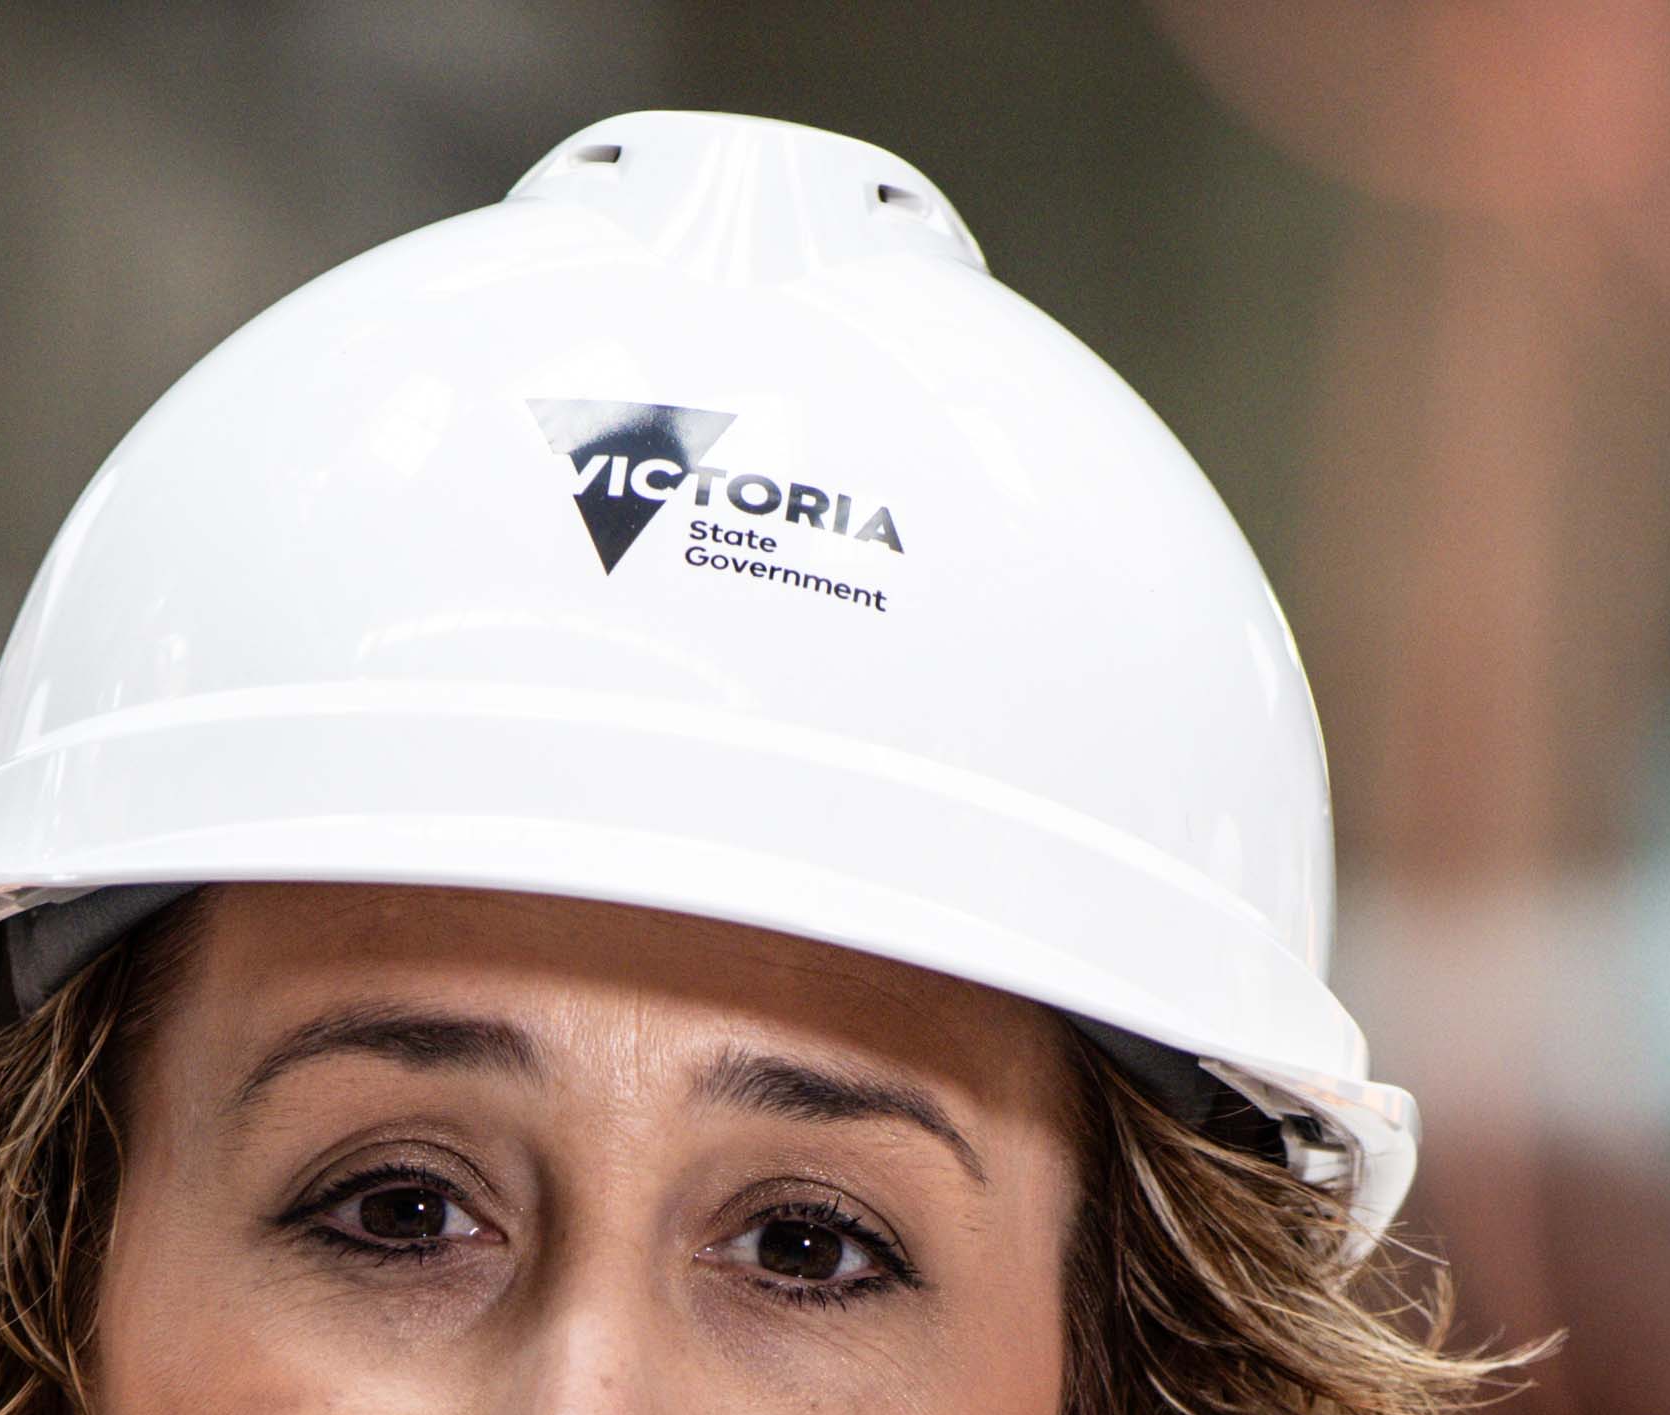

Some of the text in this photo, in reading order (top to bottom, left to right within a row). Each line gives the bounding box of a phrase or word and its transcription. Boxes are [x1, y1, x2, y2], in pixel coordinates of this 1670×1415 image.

[555, 453, 905, 555] VICTORIA
[690, 520, 778, 553] State
[685, 546, 888, 613] Government
